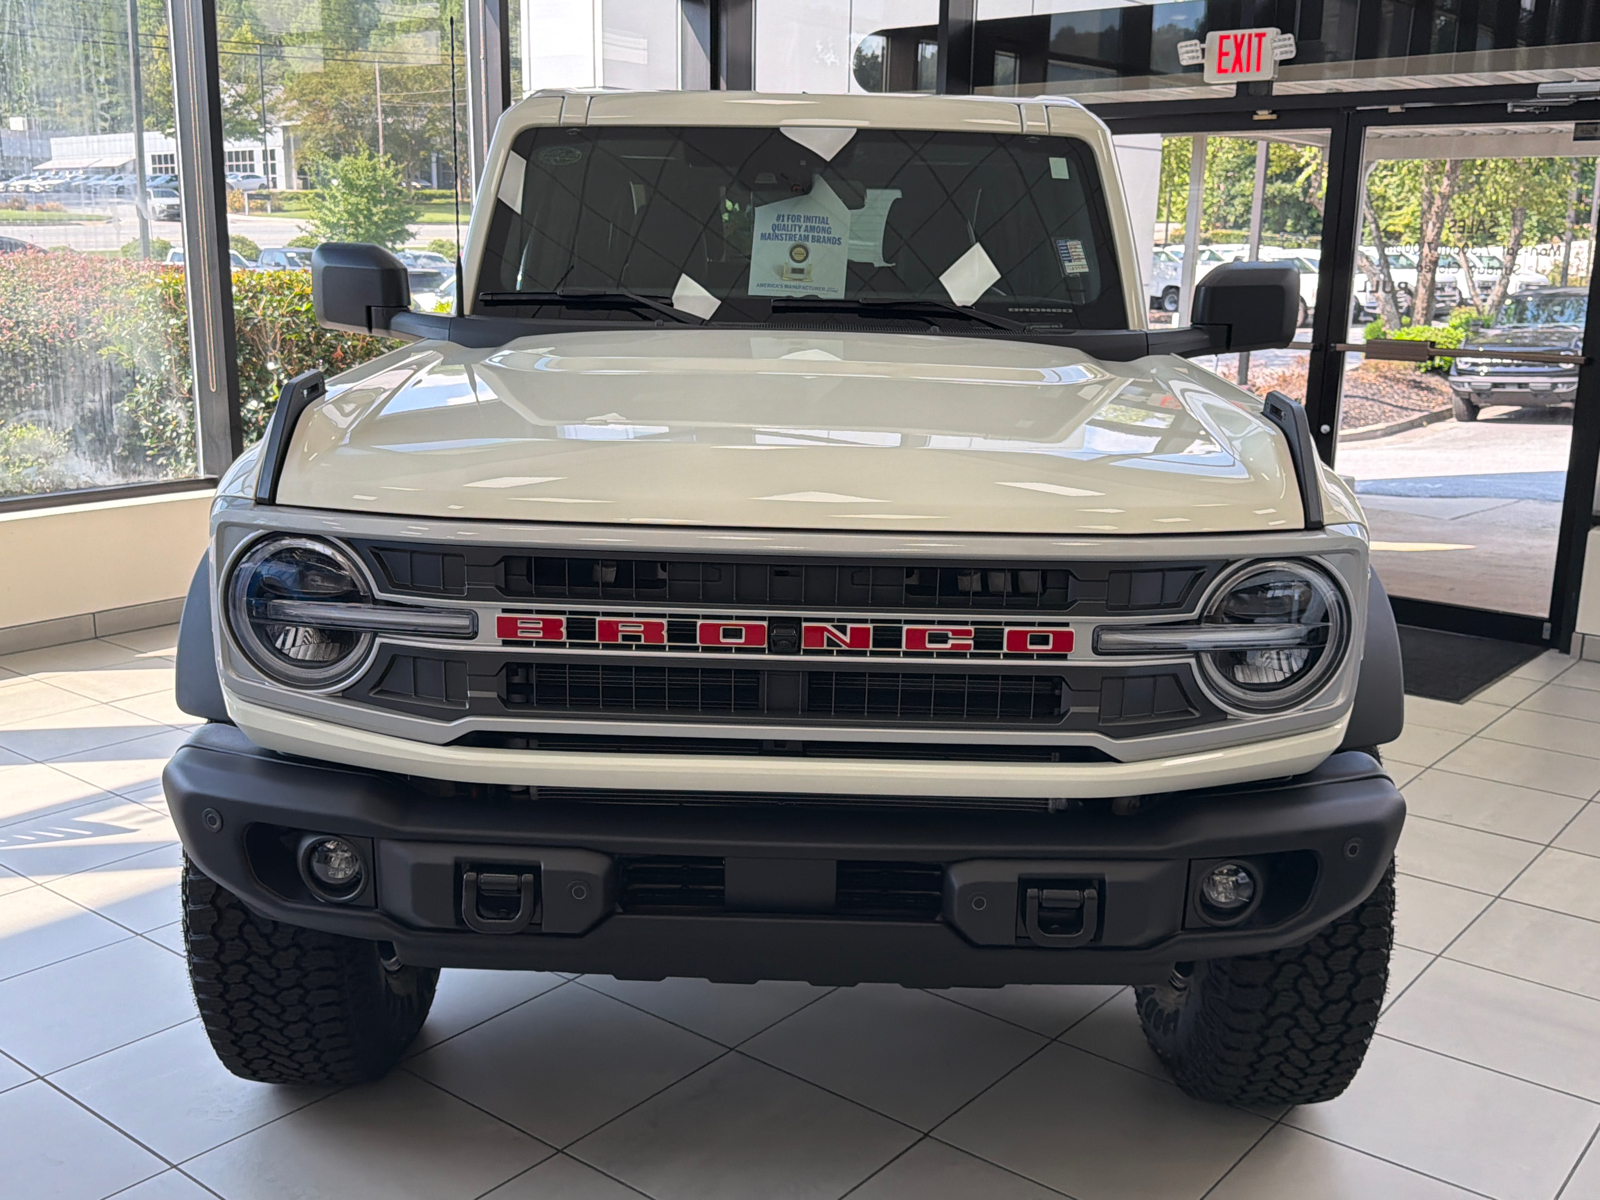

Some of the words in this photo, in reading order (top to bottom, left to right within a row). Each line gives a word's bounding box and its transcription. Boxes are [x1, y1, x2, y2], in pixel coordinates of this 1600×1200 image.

[1216, 32, 1267, 74] EXIT
[776, 214, 785, 223] #1
[786, 214, 802, 223] FOR
[803, 215, 829, 225] INITIAL
[772, 223, 802, 233] QUALITY
[804, 225, 832, 235] AMONG
[760, 232, 810, 243] MAINSTREAM
[811, 235, 842, 245] BRANDS
[496, 614, 1076, 655] BRONCO
